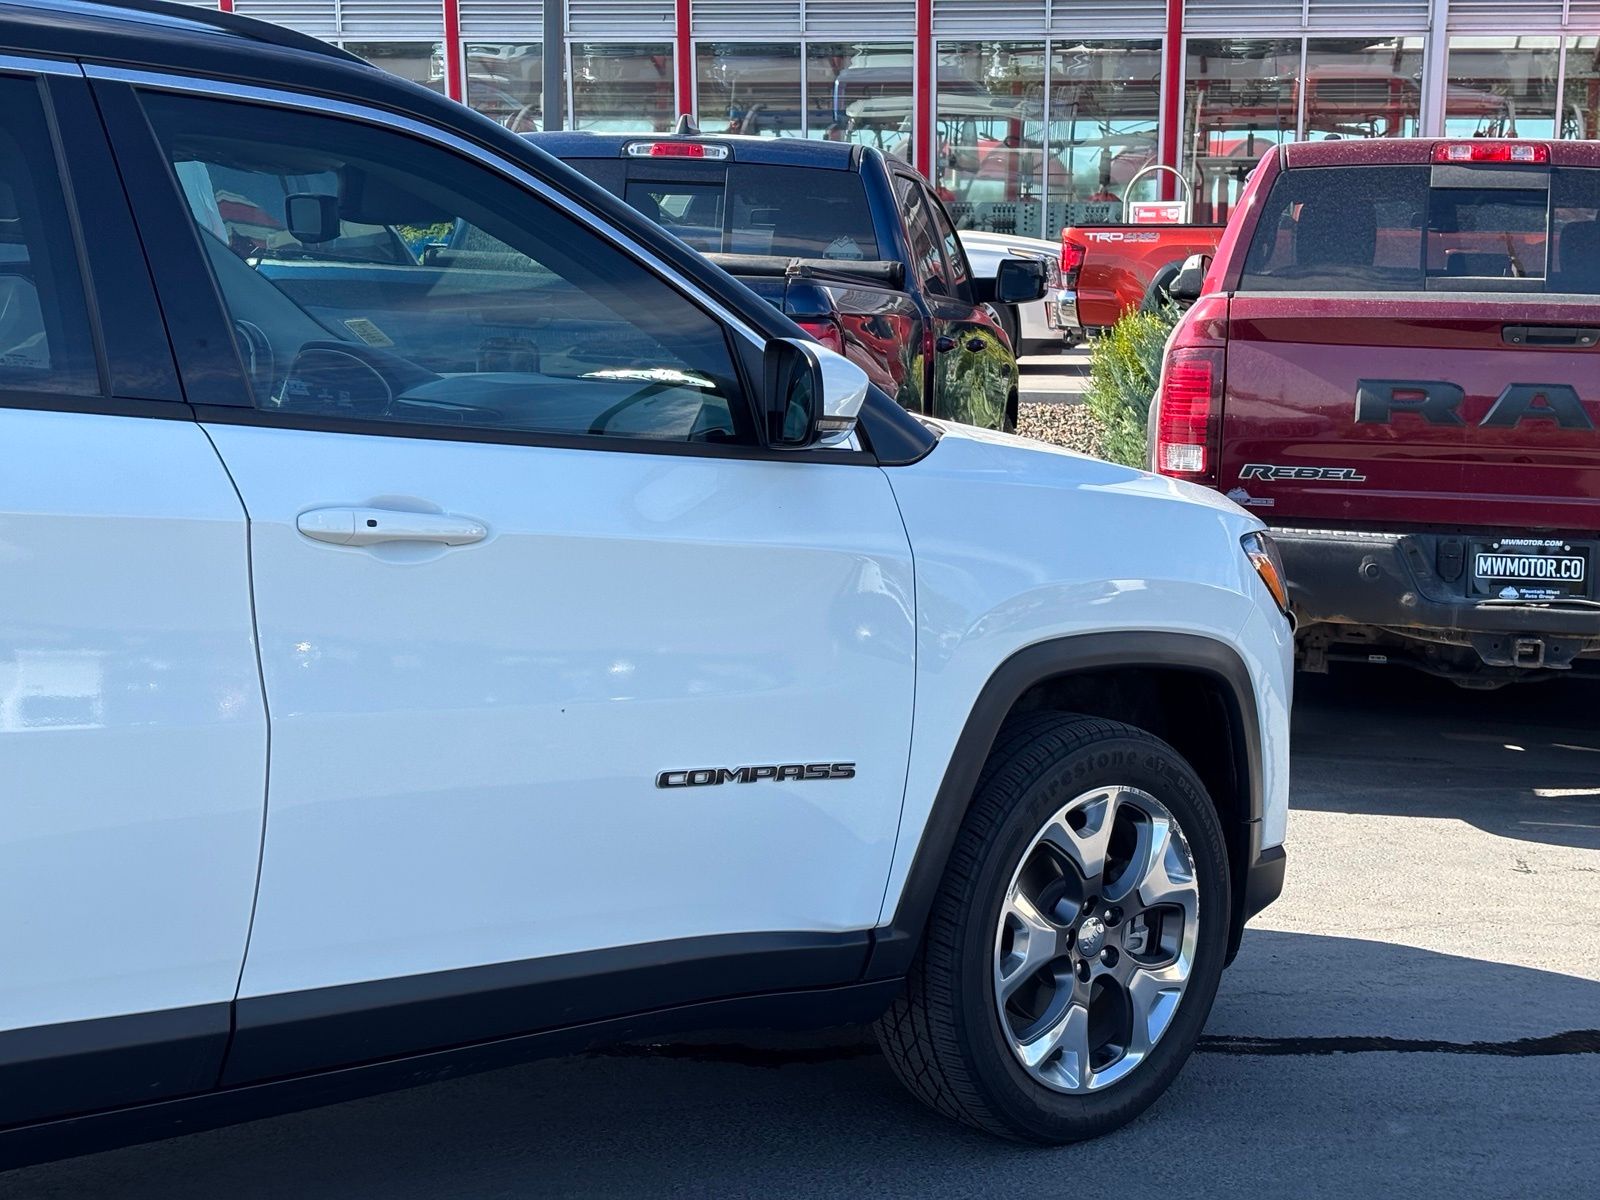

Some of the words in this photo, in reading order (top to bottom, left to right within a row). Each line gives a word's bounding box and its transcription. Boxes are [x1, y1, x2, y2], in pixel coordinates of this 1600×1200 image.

[1084, 232, 1124, 243] TRD
[1238, 464, 1367, 482] REBEL
[1500, 538, 1564, 547] MWMOTOR.COM
[1479, 556, 1581, 579] MWMOTOR.CO
[655, 761, 857, 789] COMPASS
